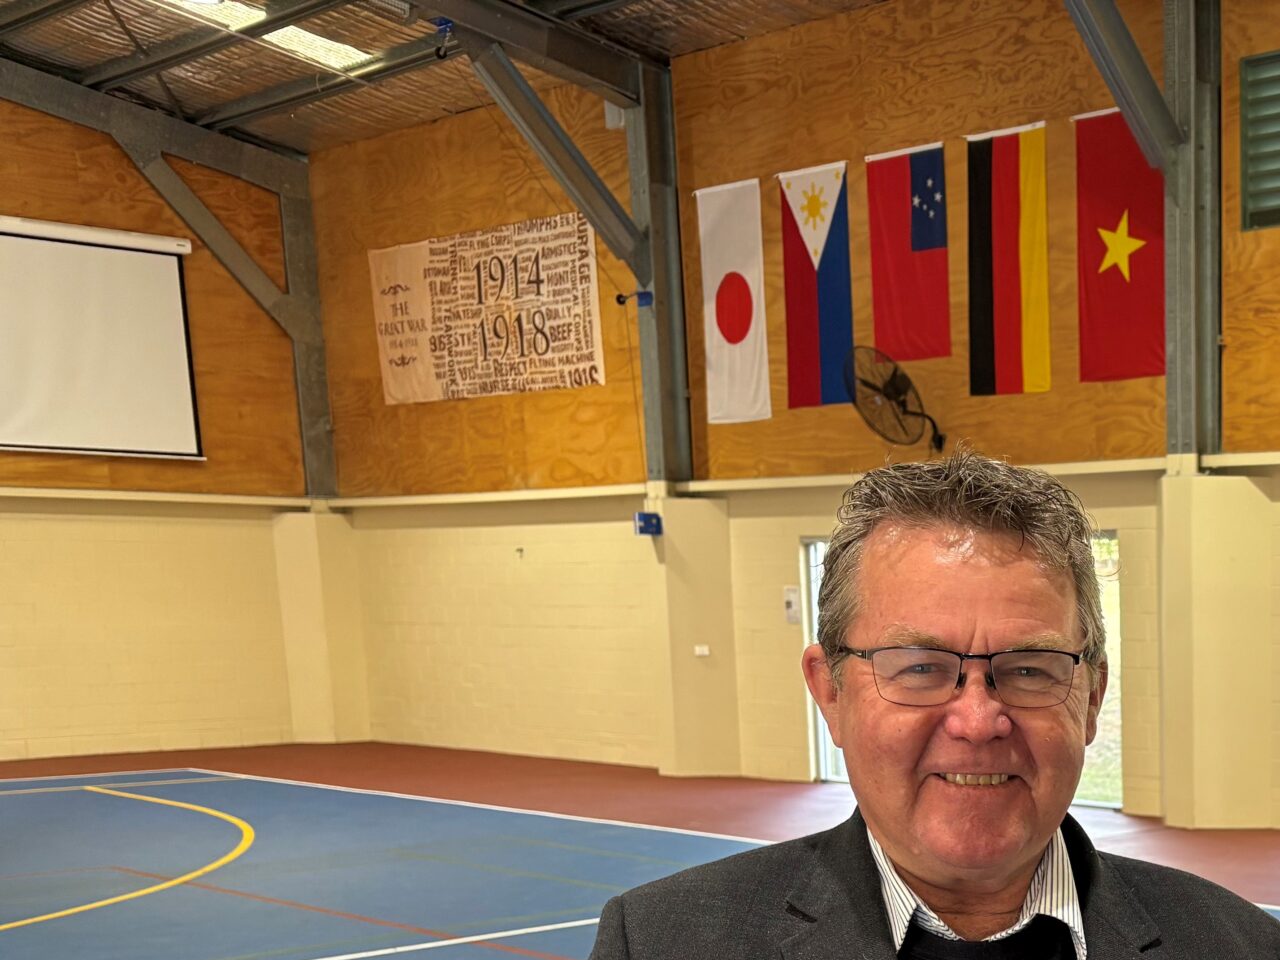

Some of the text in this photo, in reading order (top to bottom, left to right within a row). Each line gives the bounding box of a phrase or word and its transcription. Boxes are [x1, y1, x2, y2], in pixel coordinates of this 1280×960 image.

[472, 250, 545, 306] 1914
[407, 317, 429, 333] WAR
[479, 309, 551, 362] 1918
[548, 322, 574, 344] BEEF
